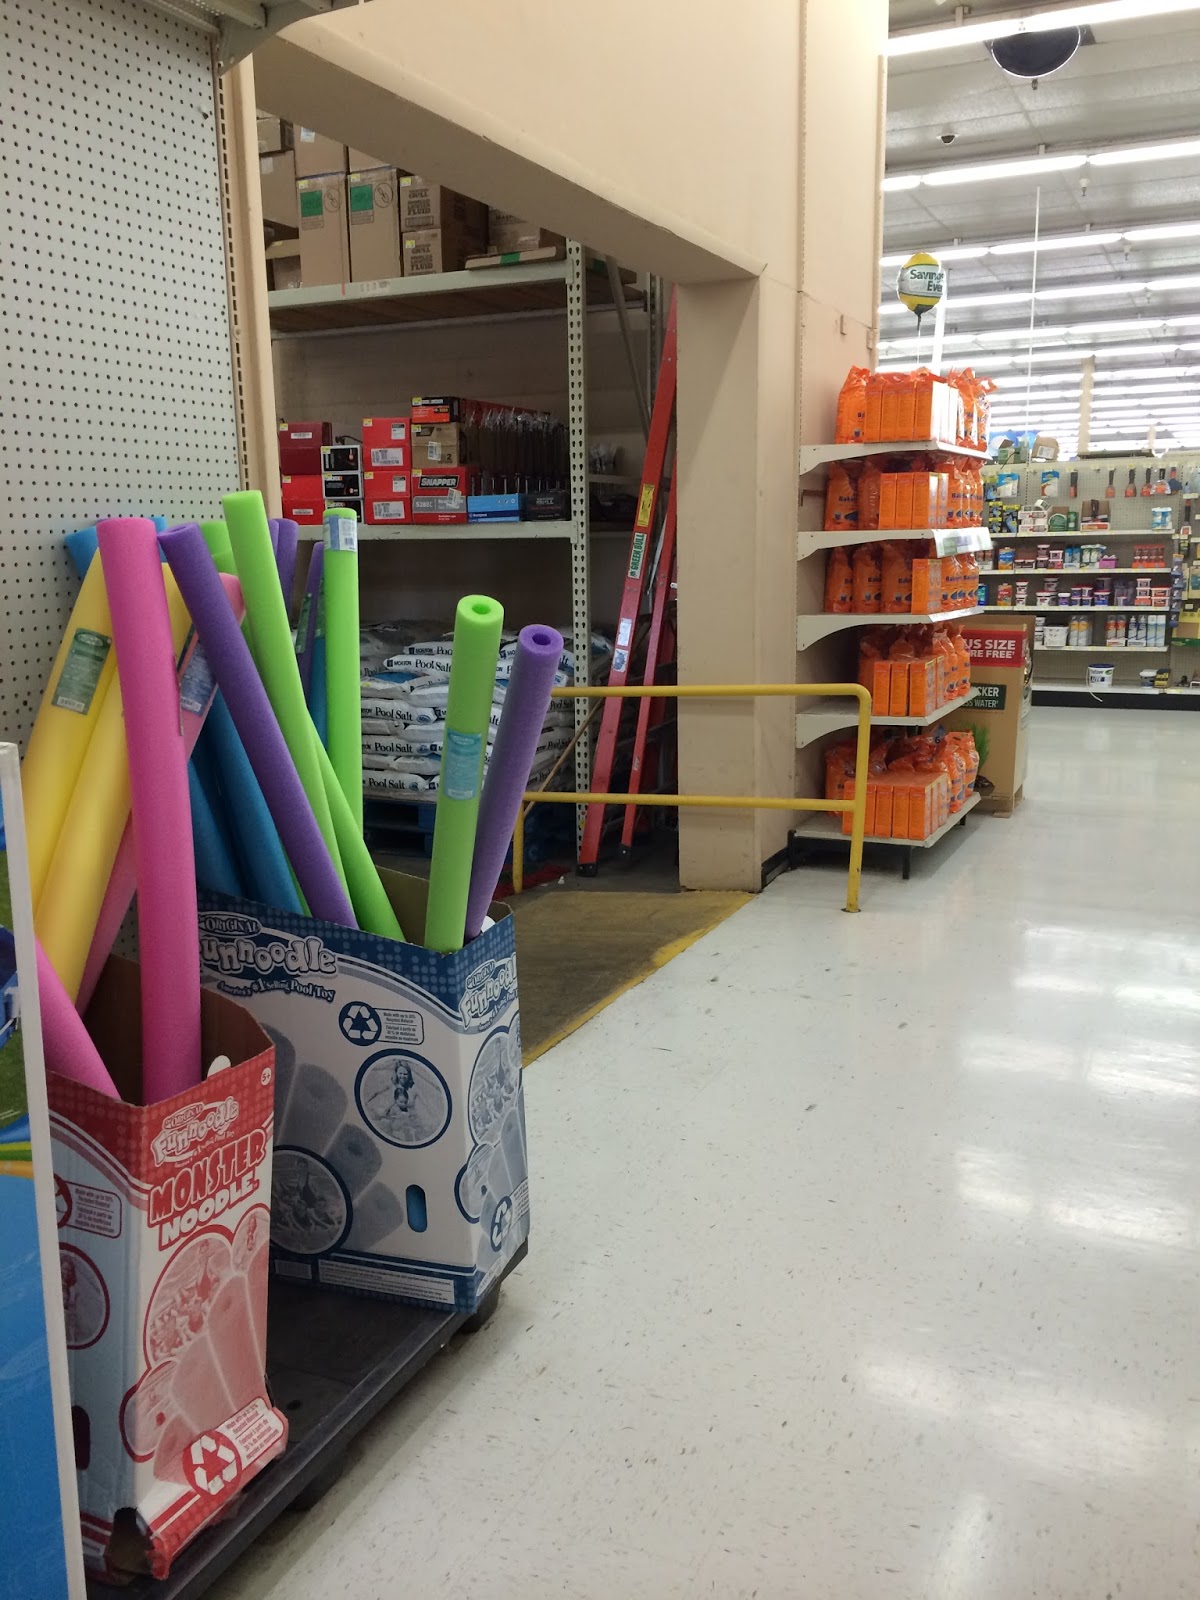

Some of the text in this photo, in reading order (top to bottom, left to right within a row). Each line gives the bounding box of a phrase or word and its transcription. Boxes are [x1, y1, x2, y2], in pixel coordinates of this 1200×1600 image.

[407, 208, 431, 216] FLUID
[410, 263, 433, 271] FLUID
[421, 476, 456, 487] SNAPPER
[633, 532, 645, 552] BULL
[629, 551, 641, 571] GREEN
[436, 645, 453, 655] Poo
[965, 638, 1016, 650] US SIZE
[970, 649, 984, 658] RE
[415, 658, 434, 669] Pool
[979, 686, 999, 697] CKER
[375, 707, 394, 718] Pool
[395, 708, 413, 721] Salt
[374, 742, 394, 752] Pool
[395, 743, 413, 753] Salt
[368, 777, 406, 790] Pool Salt
[205, 916, 259, 933] ORIGINAL
[200, 938, 337, 974] unnoodle
[266, 979, 290, 994] Selling
[290, 979, 313, 997] Pool
[314, 982, 336, 1002] Toy
[262, 1073, 271, 1082] 5+
[172, 1104, 203, 1127] ORIGINAL
[153, 1096, 239, 1167] Funnoodle
[149, 1128, 267, 1224] MONSTER
[160, 1171, 255, 1247] NOODLE
